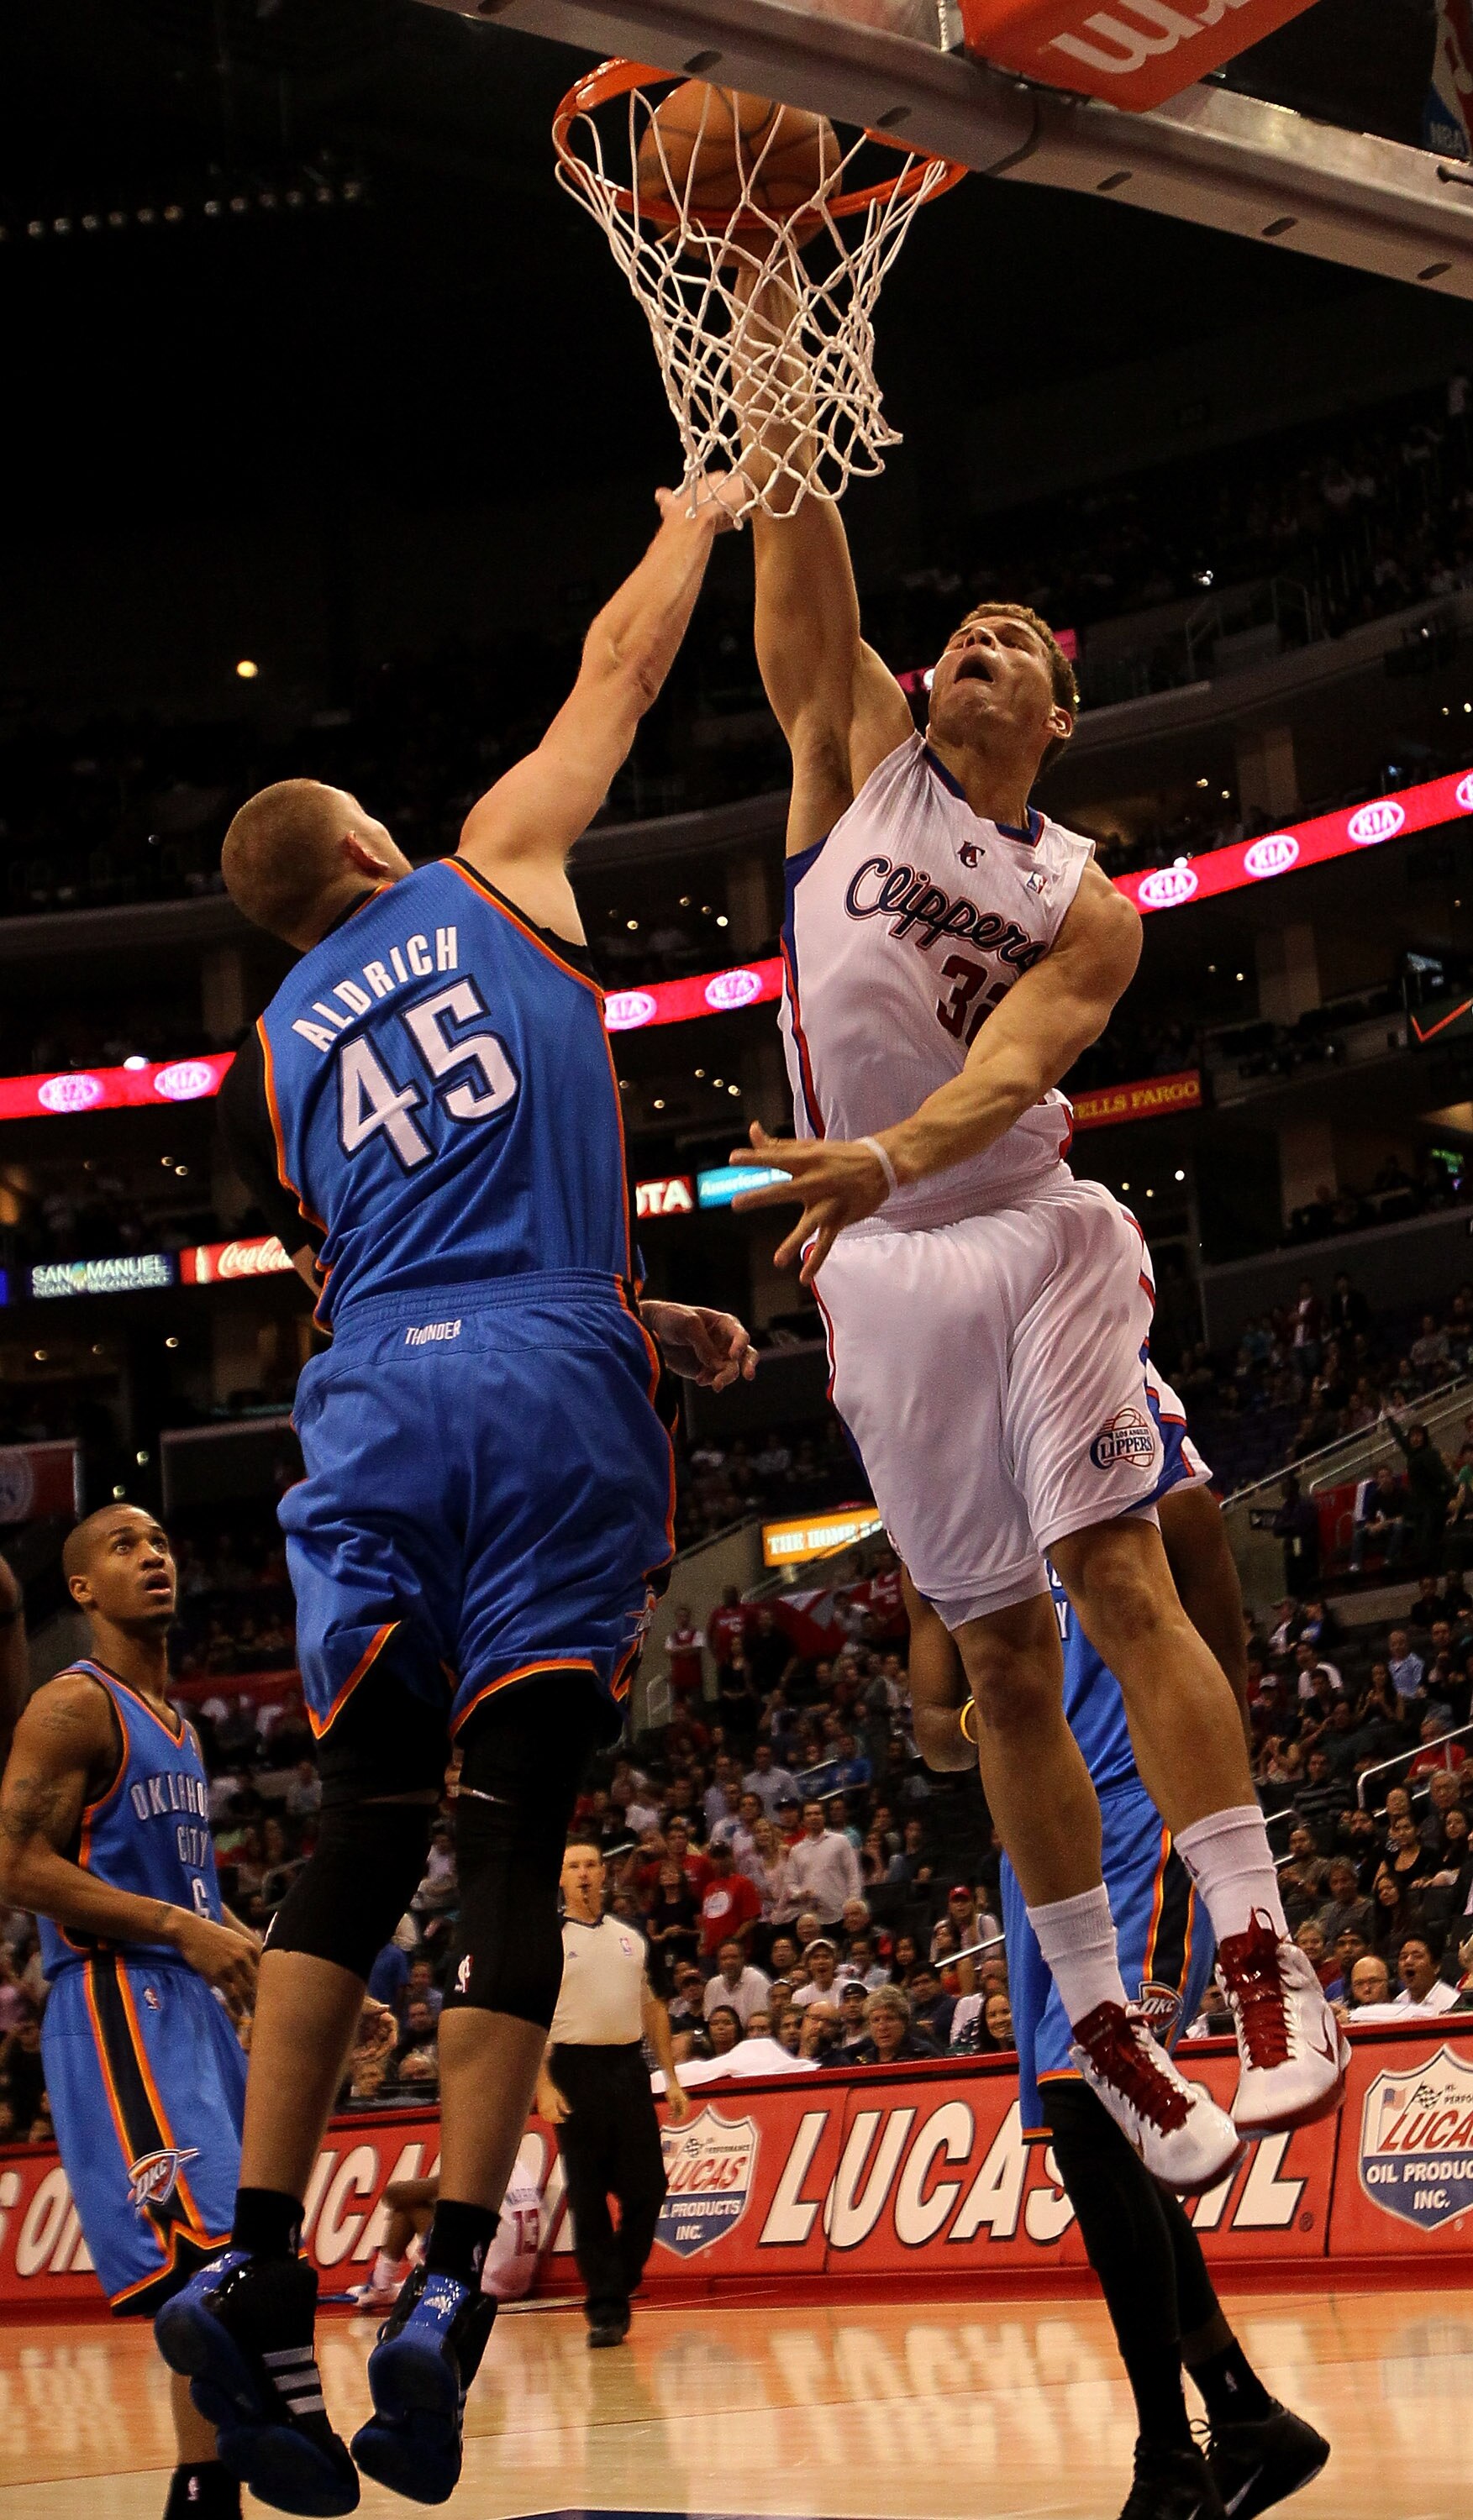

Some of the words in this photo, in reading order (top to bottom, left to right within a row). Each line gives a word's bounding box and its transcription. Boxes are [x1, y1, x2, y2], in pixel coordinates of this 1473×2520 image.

[844, 853, 1050, 972] Clippers
[292, 927, 458, 1053] ALDRICH
[338, 974, 521, 1179] 45
[1075, 1094, 1127, 1118] ELLS
[1131, 1080, 1199, 1107] FARGO
[32, 1264, 71, 1284] SAN
[86, 1254, 169, 1278] MANUEL
[405, 1320, 461, 1345] THUNDER
[1090, 1431, 1153, 1469] CLIPPERS
[767, 1532, 804, 1555] THE
[130, 1774, 209, 1821] OKLAHO
[177, 1824, 209, 1867] CITY
[1140, 1998, 1176, 2014] OKC
[1376, 2108, 1473, 2153] LUCA
[1366, 2163, 1399, 2184] OIL
[671, 2199, 741, 2218] PRODUCTS
[1413, 2188, 1451, 2210] INC.
[513, 2208, 539, 2257] 13
[676, 2224, 702, 2241] INC.
